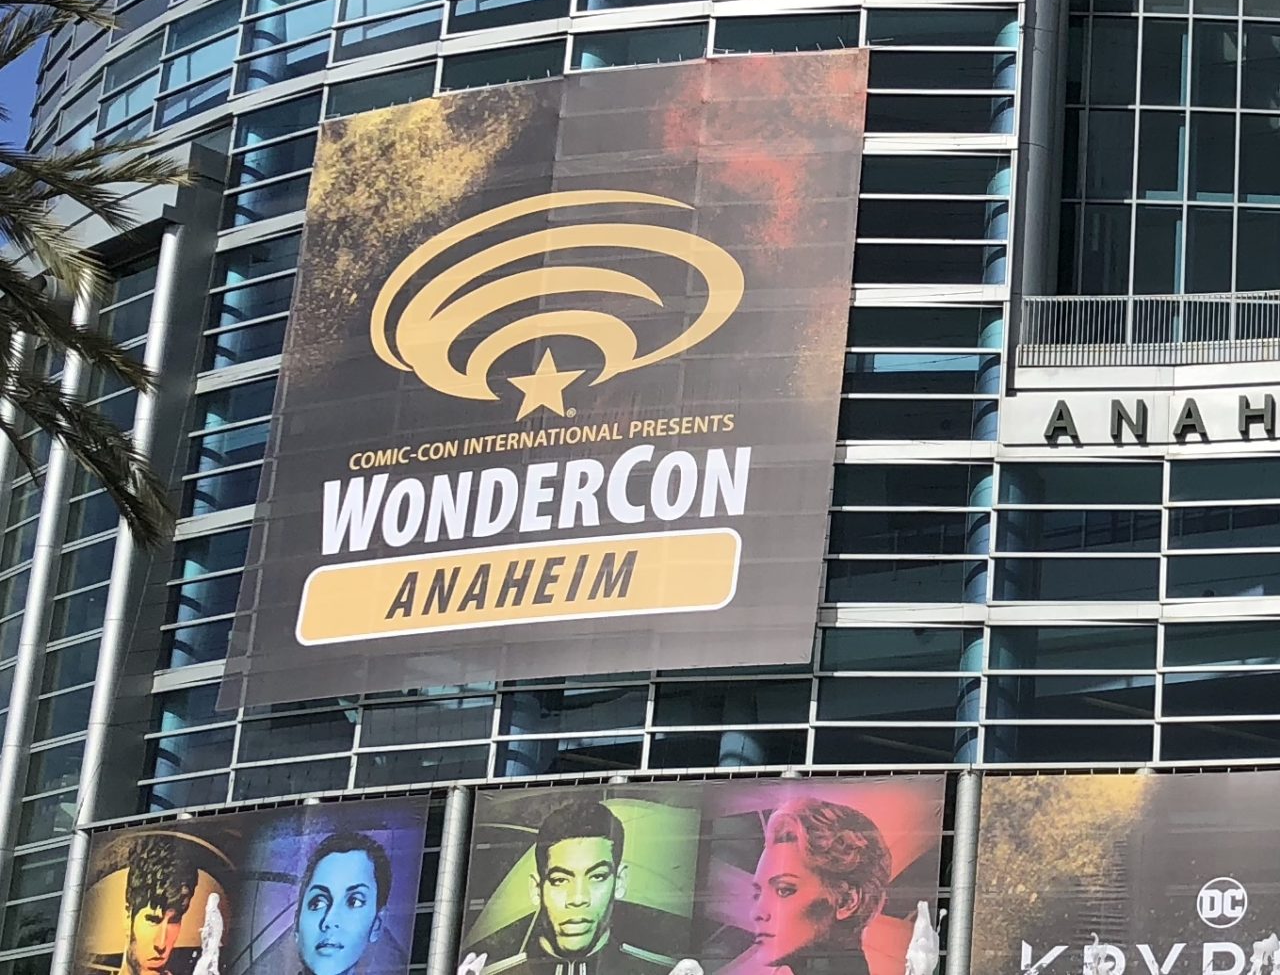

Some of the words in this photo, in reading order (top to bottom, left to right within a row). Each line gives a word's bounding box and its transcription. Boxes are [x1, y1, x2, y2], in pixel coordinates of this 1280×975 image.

[349, 440, 458, 471] COMIC-CON
[463, 422, 622, 456] INTERNATIONAL
[629, 414, 735, 439] PRESENTS
[385, 549, 639, 620] ANAHEIM
[1198, 886, 1247, 920] DC
